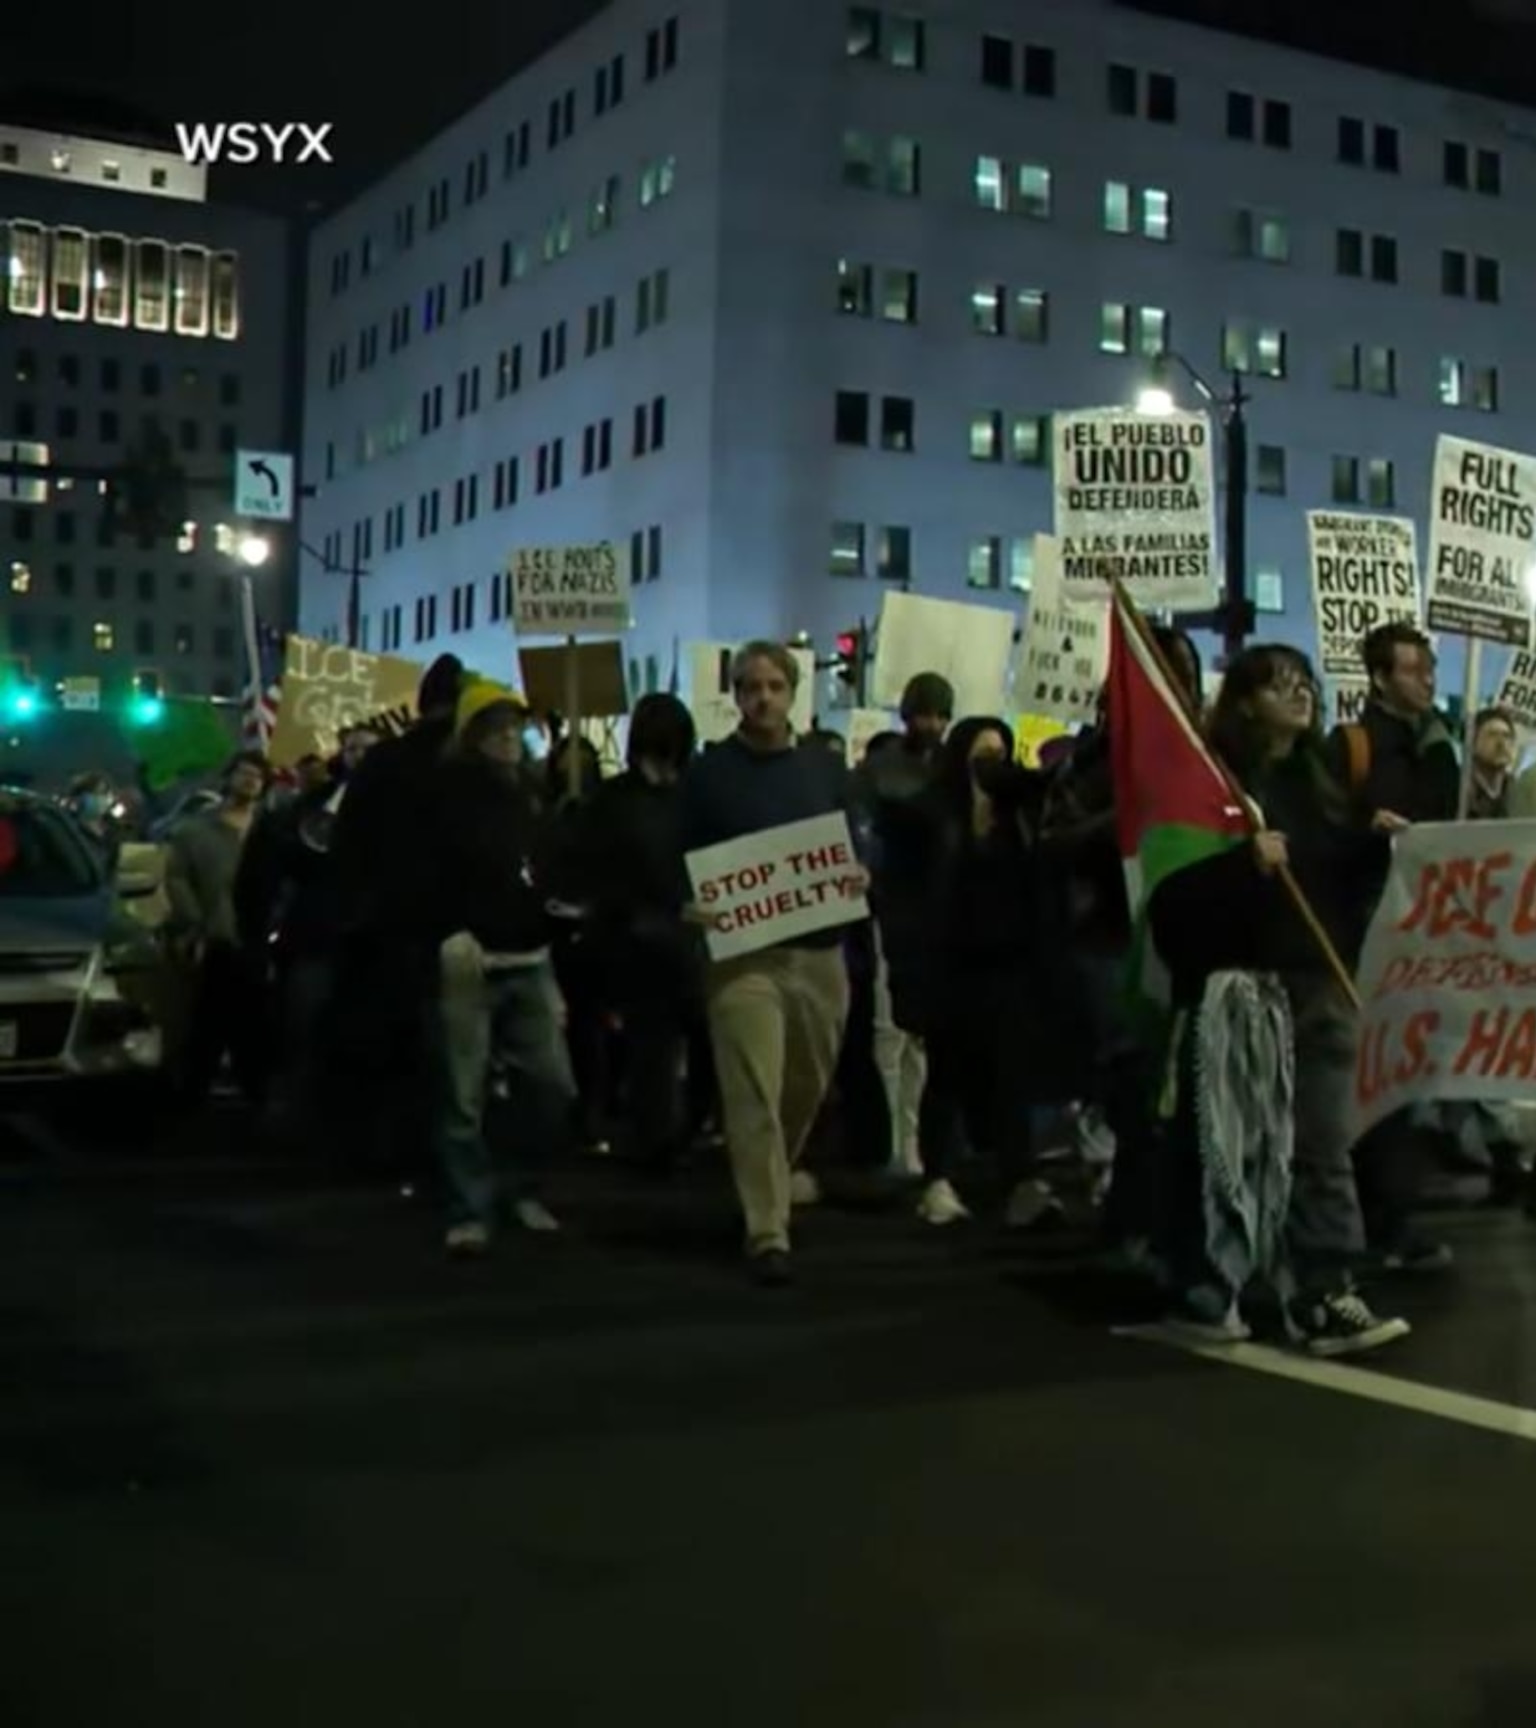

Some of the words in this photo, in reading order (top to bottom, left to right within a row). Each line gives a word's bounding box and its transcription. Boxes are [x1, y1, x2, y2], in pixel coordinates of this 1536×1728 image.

[1111, 423, 1204, 447] PUEBLO
[1075, 448, 1190, 484] UNIDO
[1460, 450, 1521, 499] FULL
[1440, 486, 1535, 540] RIGHTS
[1062, 536, 1077, 556] A
[1081, 535, 1118, 554] LAS
[1123, 532, 1209, 553] FAMILIAS
[1437, 544, 1484, 582] FOR
[1316, 555, 1415, 598] RIGHTS!
[1321, 597, 1379, 634] STOP
[287, 634, 380, 687] ICE
[699, 862, 775, 903] STOP
[786, 842, 849, 875] THE
[714, 873, 852, 934] CRUELTY
[1356, 1010, 1441, 1107] U.S.
